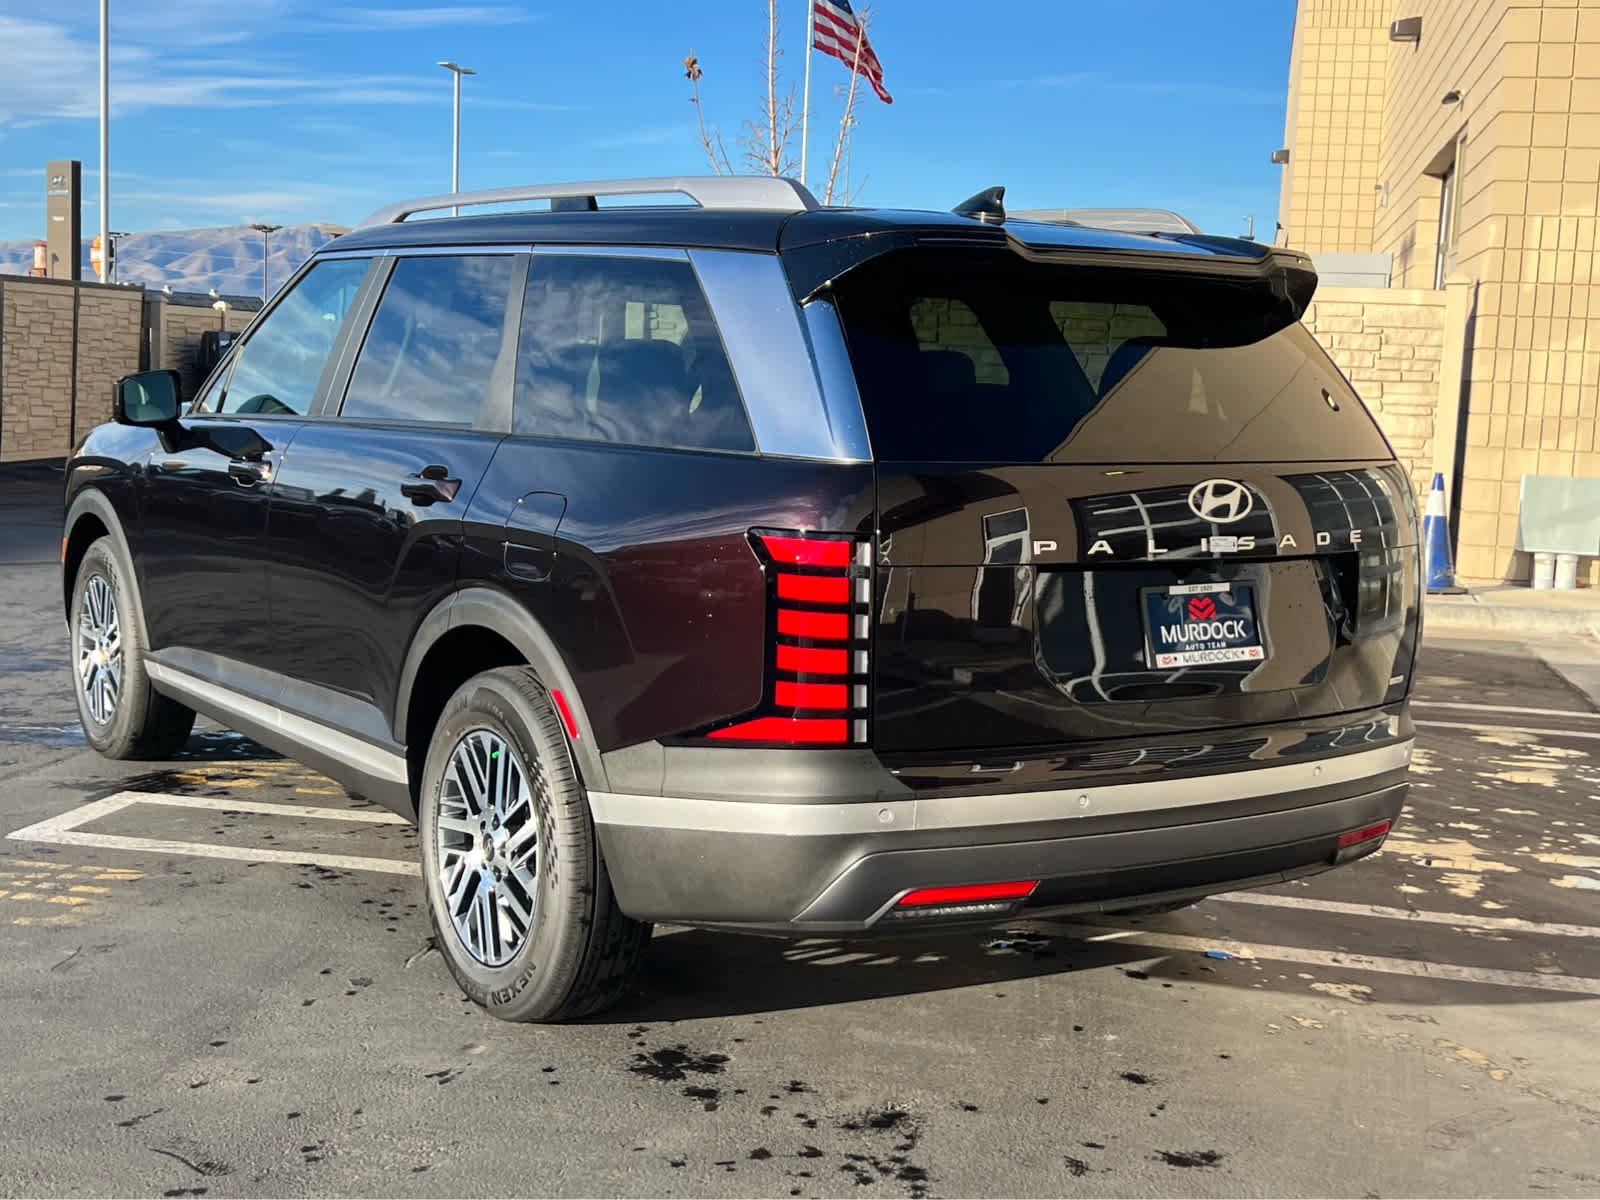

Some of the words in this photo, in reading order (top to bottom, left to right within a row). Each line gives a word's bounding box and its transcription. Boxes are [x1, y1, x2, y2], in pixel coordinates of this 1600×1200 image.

[1033, 529, 1362, 555] PALISADE
[1160, 620, 1247, 644] MURDOCK
[1182, 649, 1240, 663] MURDOCK
[1185, 642, 1205, 650] AUTO
[1208, 641, 1226, 649] TEAM
[491, 961, 537, 1006] NEXEN
